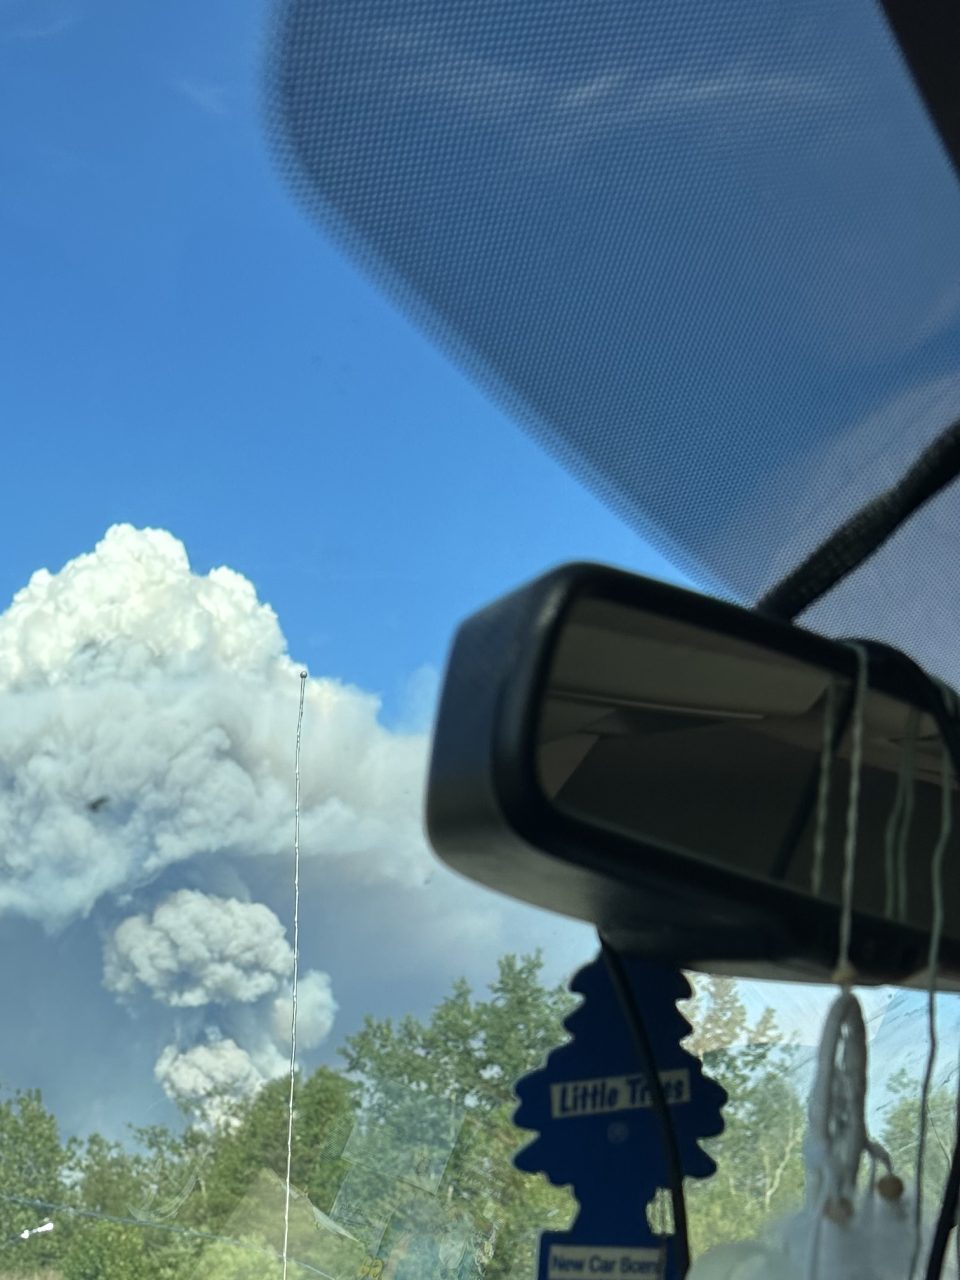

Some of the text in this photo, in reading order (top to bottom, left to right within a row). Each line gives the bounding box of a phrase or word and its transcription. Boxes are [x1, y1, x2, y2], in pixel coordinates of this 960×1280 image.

[559, 1078, 684, 1114] Little Tres
[552, 1255, 585, 1272] New
[588, 1254, 616, 1273] Car
